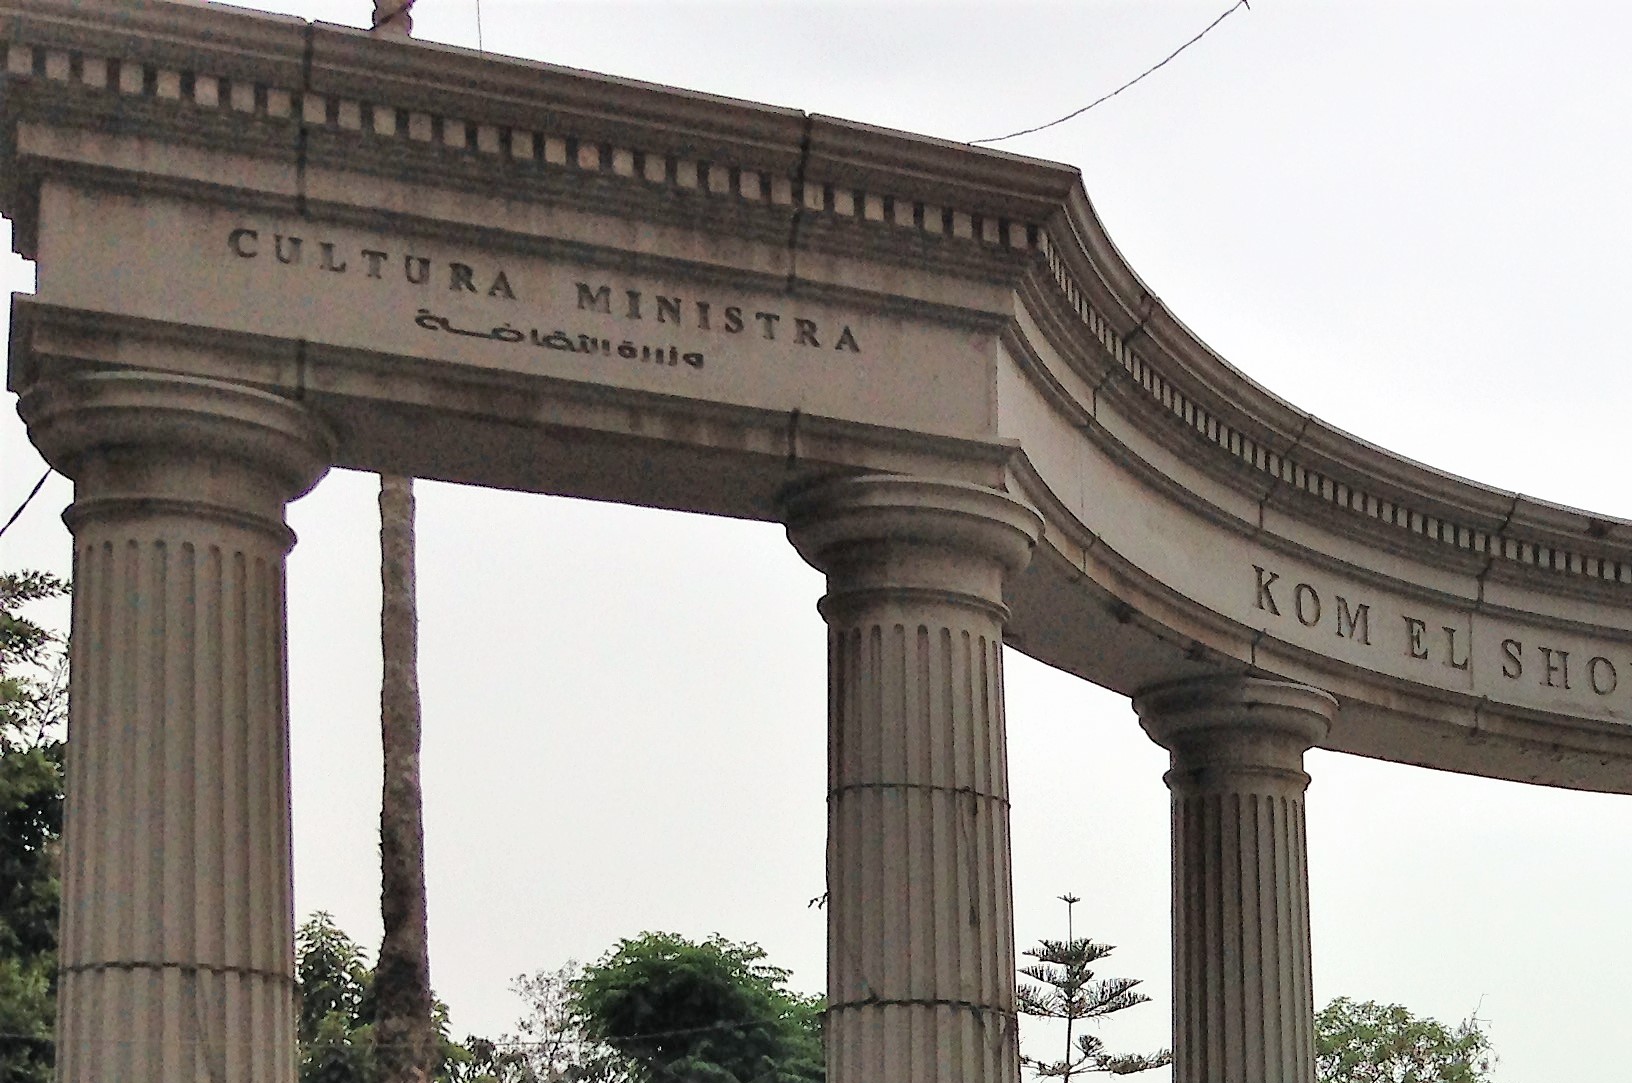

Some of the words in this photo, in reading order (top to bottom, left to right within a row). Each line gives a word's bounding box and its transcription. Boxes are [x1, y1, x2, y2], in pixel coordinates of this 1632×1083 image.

[227, 227, 517, 301] CULTURA
[575, 281, 861, 354] MINISTRA
[1252, 564, 1371, 645] KOM
[1402, 615, 1469, 671] EL
